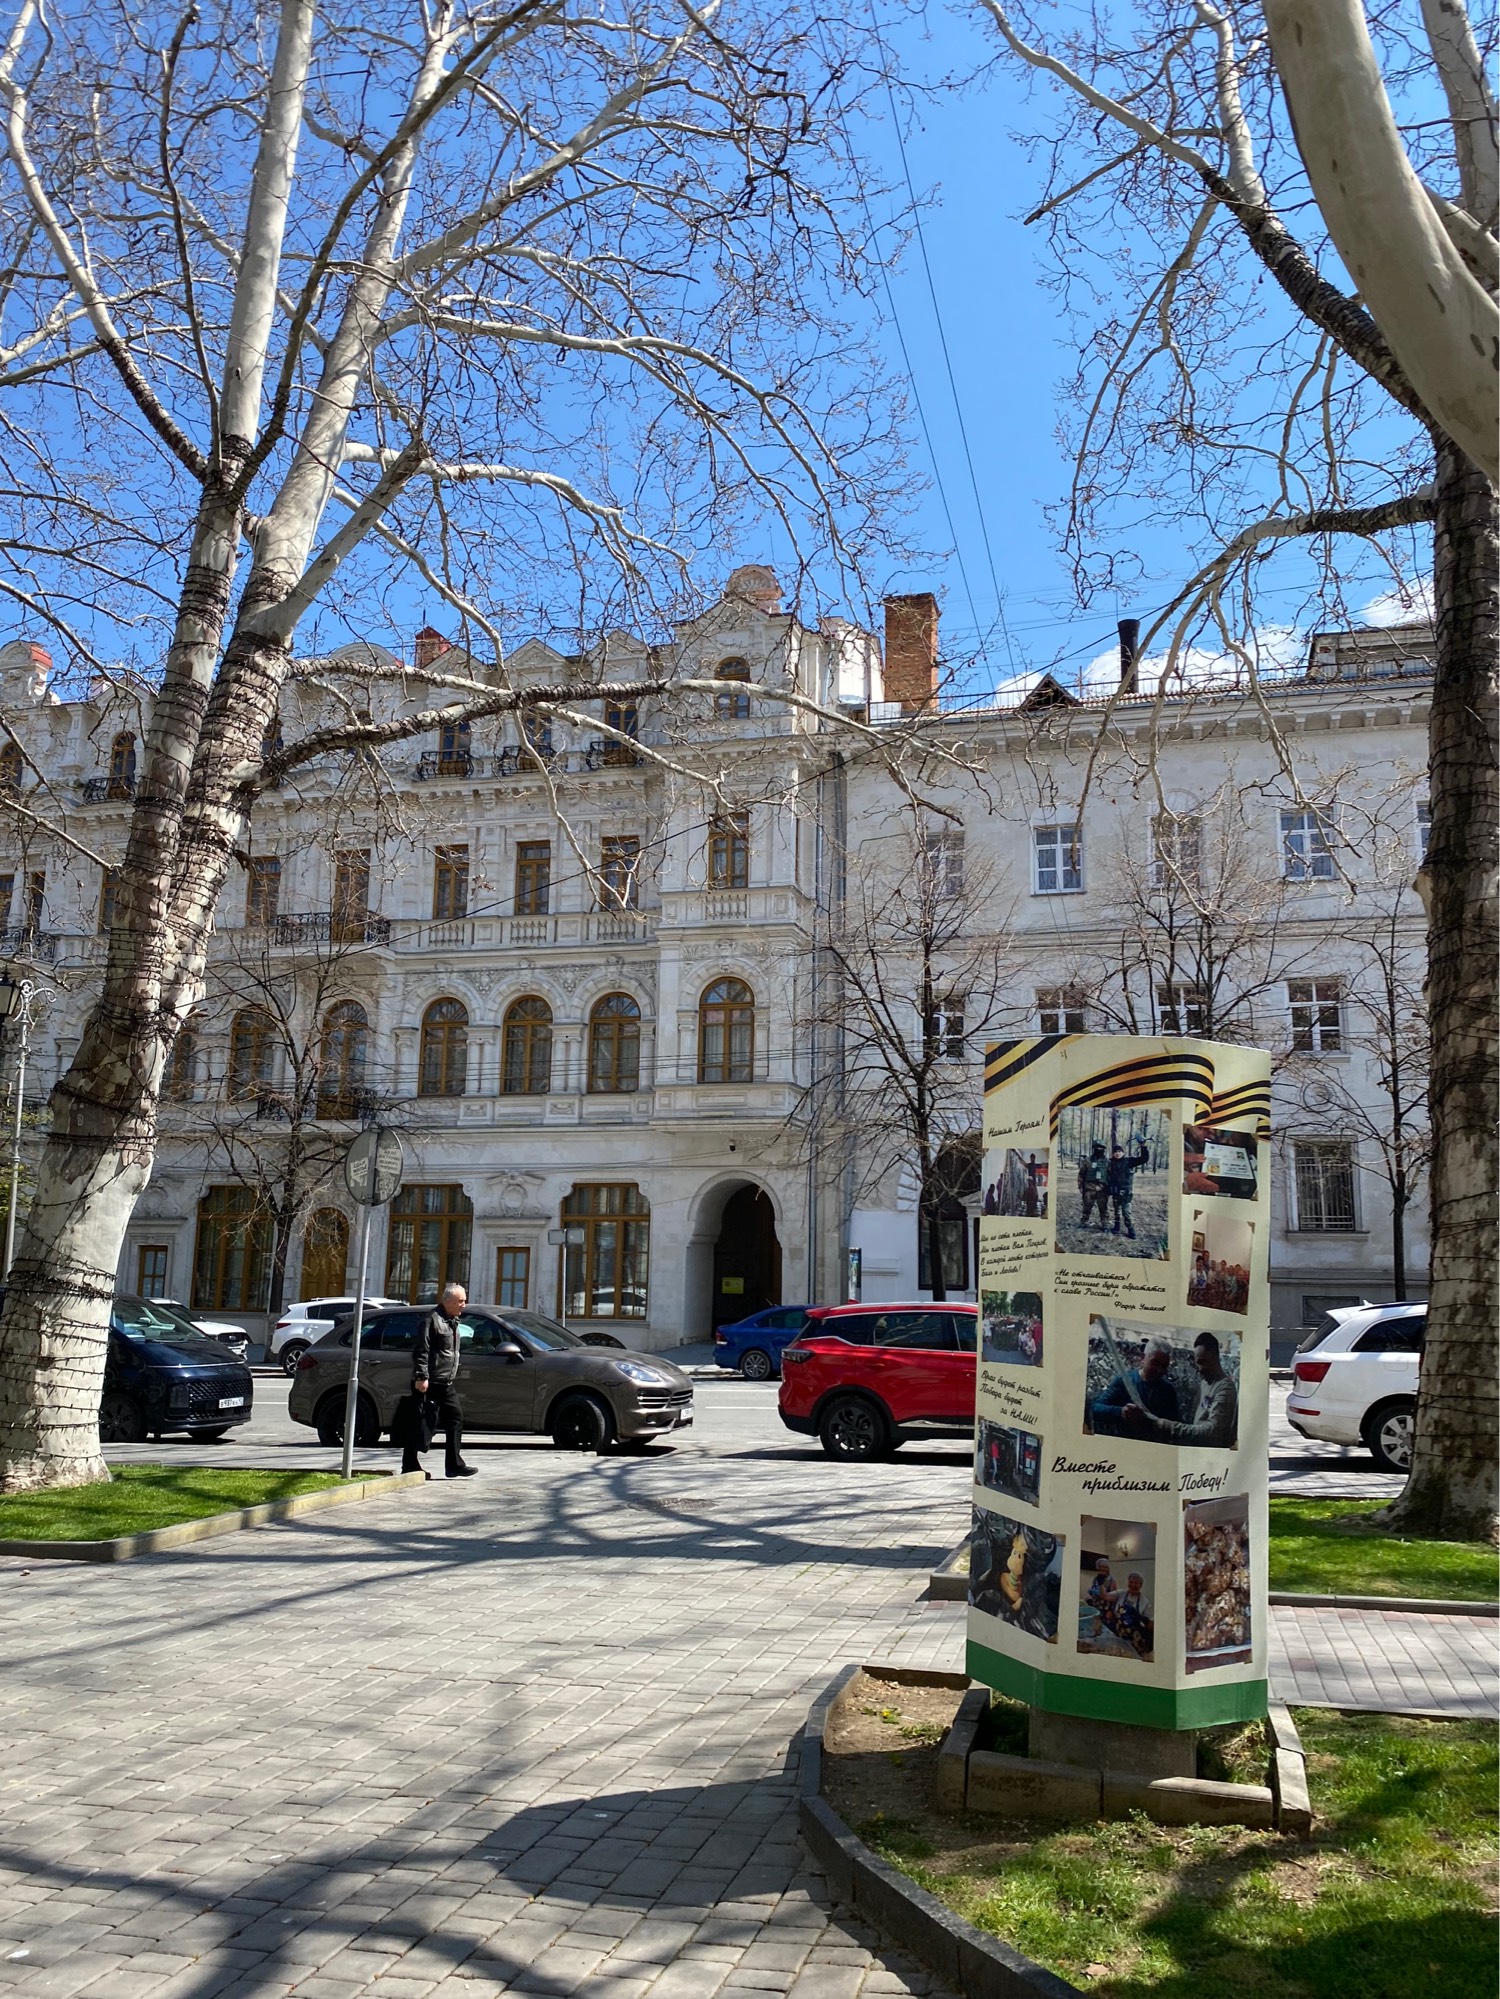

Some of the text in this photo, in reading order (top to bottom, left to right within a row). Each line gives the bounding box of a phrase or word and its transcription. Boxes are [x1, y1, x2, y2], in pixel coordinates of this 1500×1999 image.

[988, 1115, 1045, 1138] Нашим Героям!
[1012, 1241, 1024, 1249] Вам
[981, 1257, 985, 1265] В
[986, 1255, 1006, 1265] каждой
[999, 1264, 1022, 1275] Любовь!
[1071, 1271, 1130, 1281] отчаивайтесь!
[1054, 1277, 1166, 1292] Сии грозные бури обратятся
[1139, 1303, 1166, 1312] Ушаков
[981, 1370, 996, 1382] Враг
[997, 1376, 1016, 1389] будет
[979, 1383, 1023, 1406] Победа будет
[1010, 1408, 1039, 1425] НАМИ!
[1051, 1456, 1117, 1474] Вместе
[1081, 1467, 1229, 1495] приблизим Победу!
